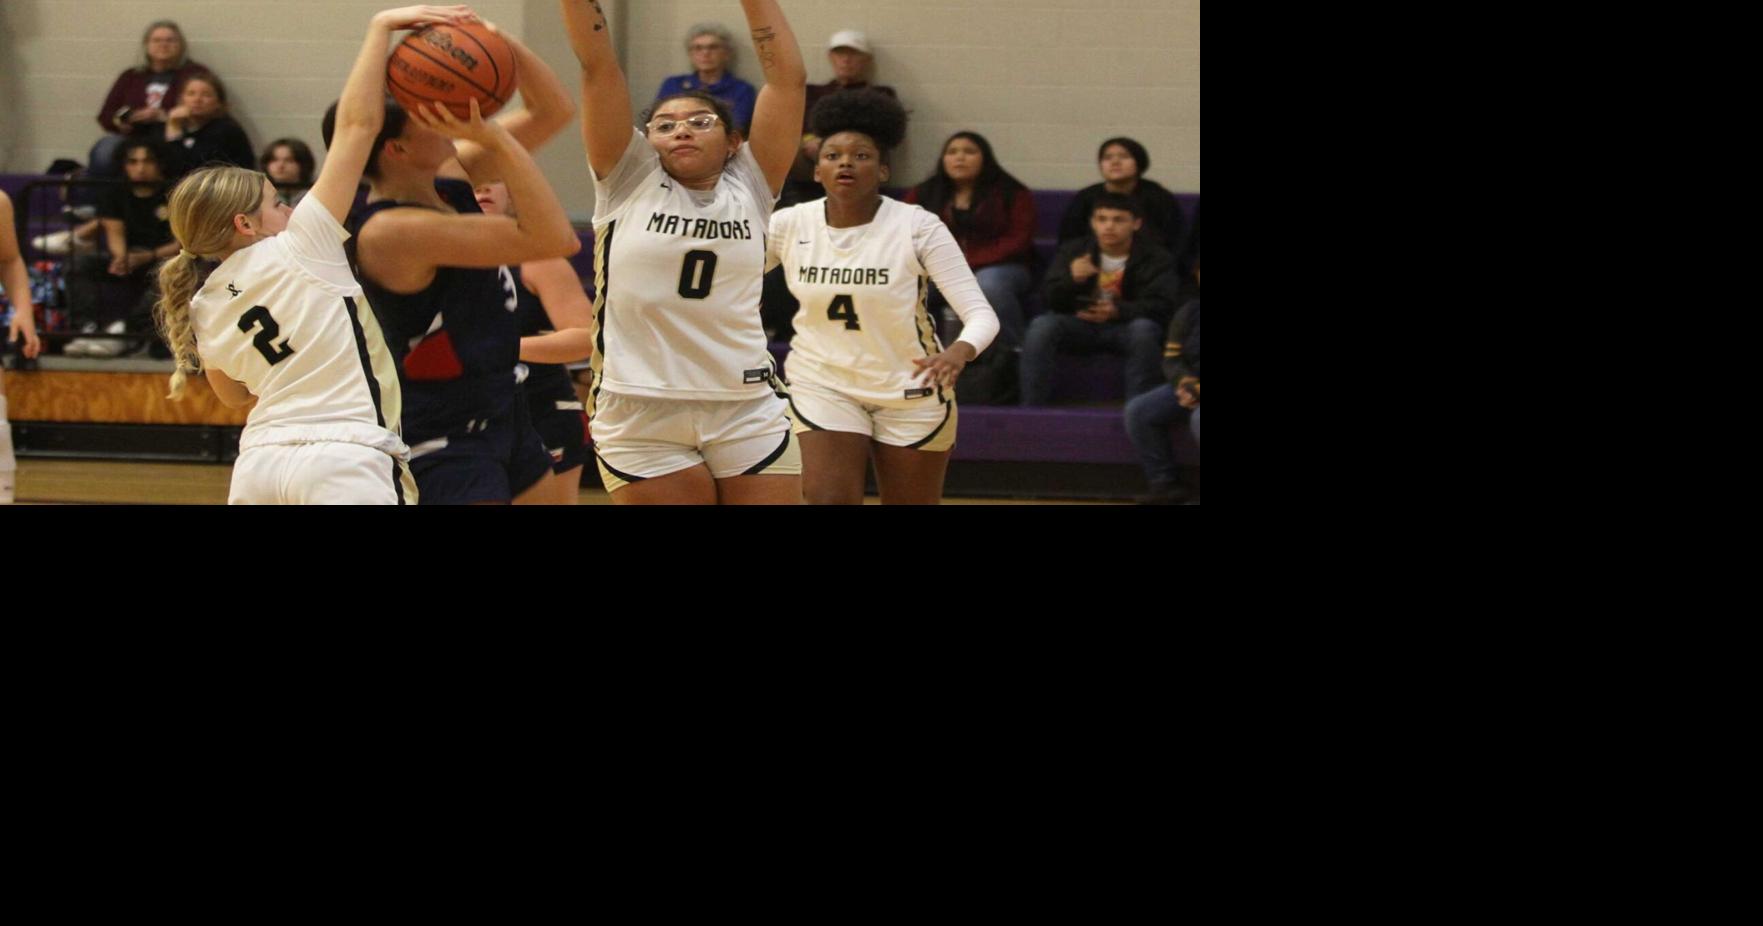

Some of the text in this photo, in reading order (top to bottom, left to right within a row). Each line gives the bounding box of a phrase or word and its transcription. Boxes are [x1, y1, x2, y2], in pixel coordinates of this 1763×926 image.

[646, 211, 752, 240] MATADORS
[678, 249, 718, 300] 0
[798, 265, 890, 285] MATADORS
[826, 294, 862, 331] 4
[237, 305, 296, 366] 2
